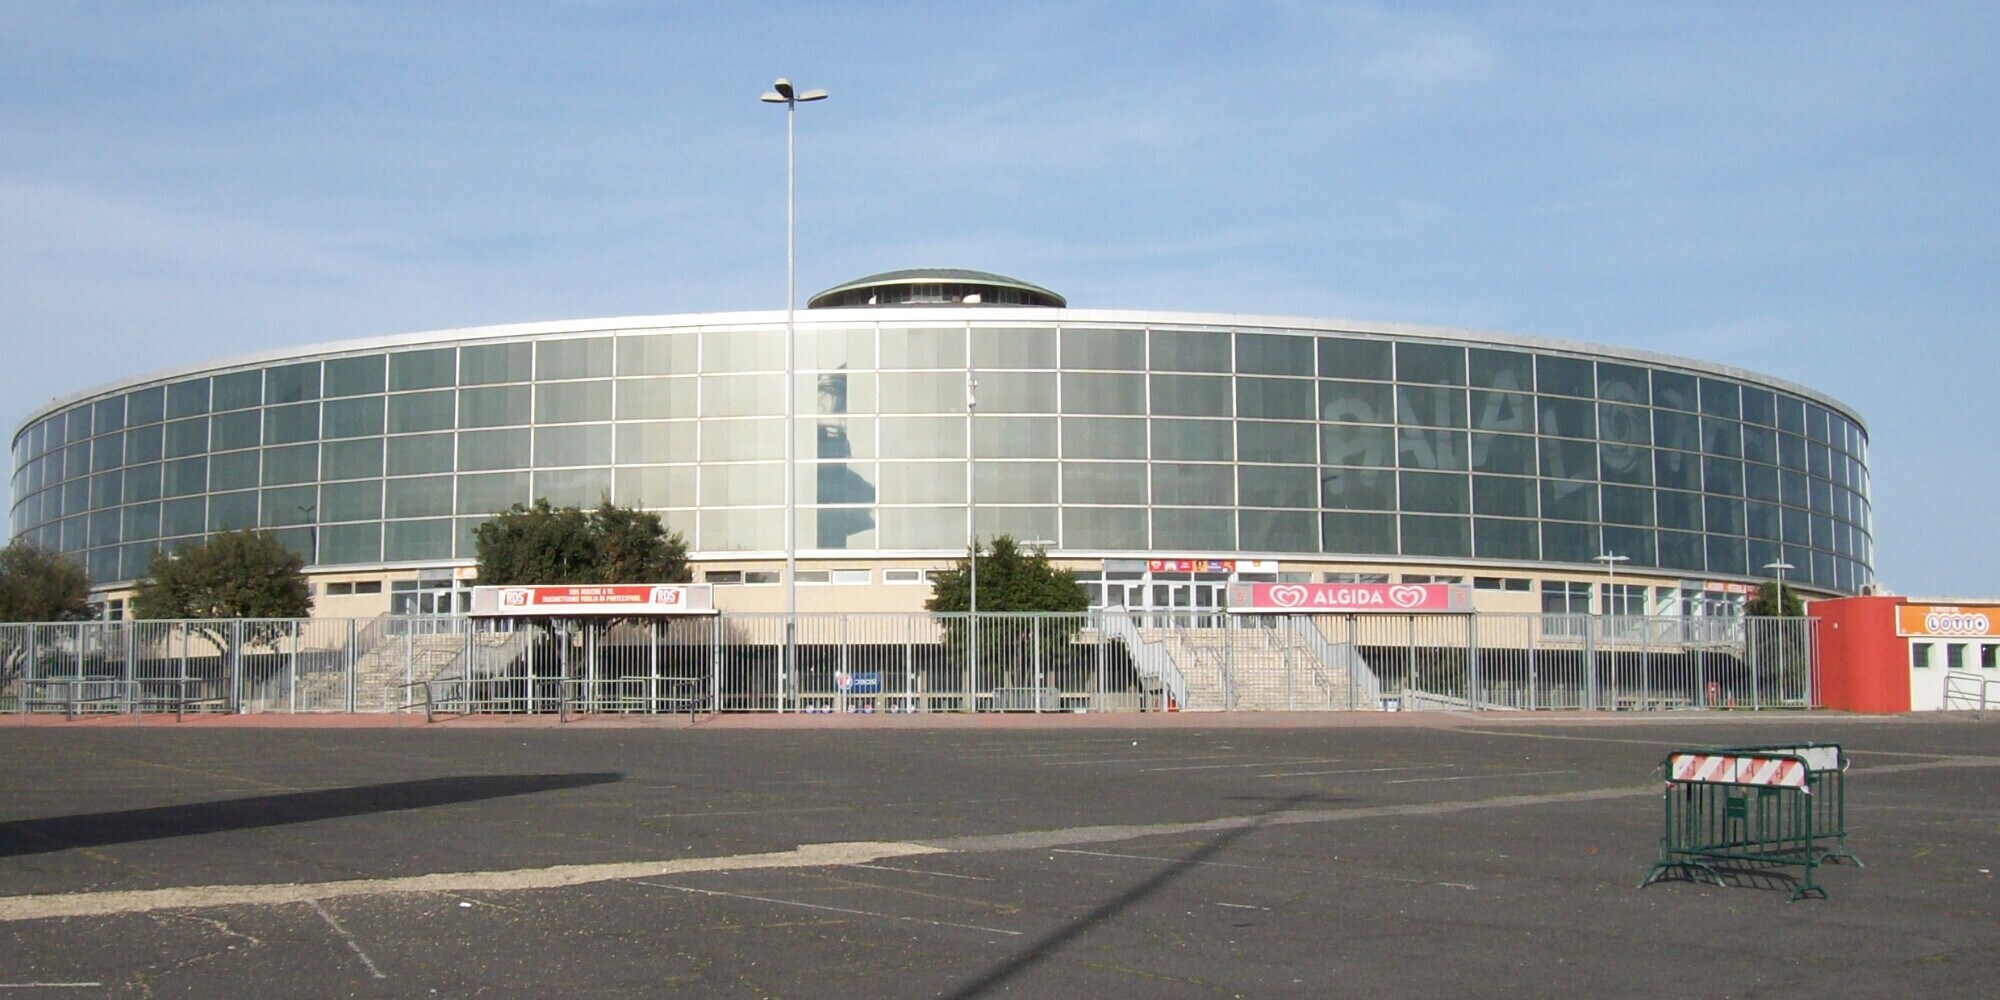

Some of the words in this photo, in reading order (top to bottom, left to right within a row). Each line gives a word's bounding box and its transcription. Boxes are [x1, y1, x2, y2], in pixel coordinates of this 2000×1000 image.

[505, 591, 524, 605] RDS
[657, 589, 676, 603] RDS
[1313, 589, 1384, 605] ALGIDA
[1928, 616, 1987, 632] LOTTO
